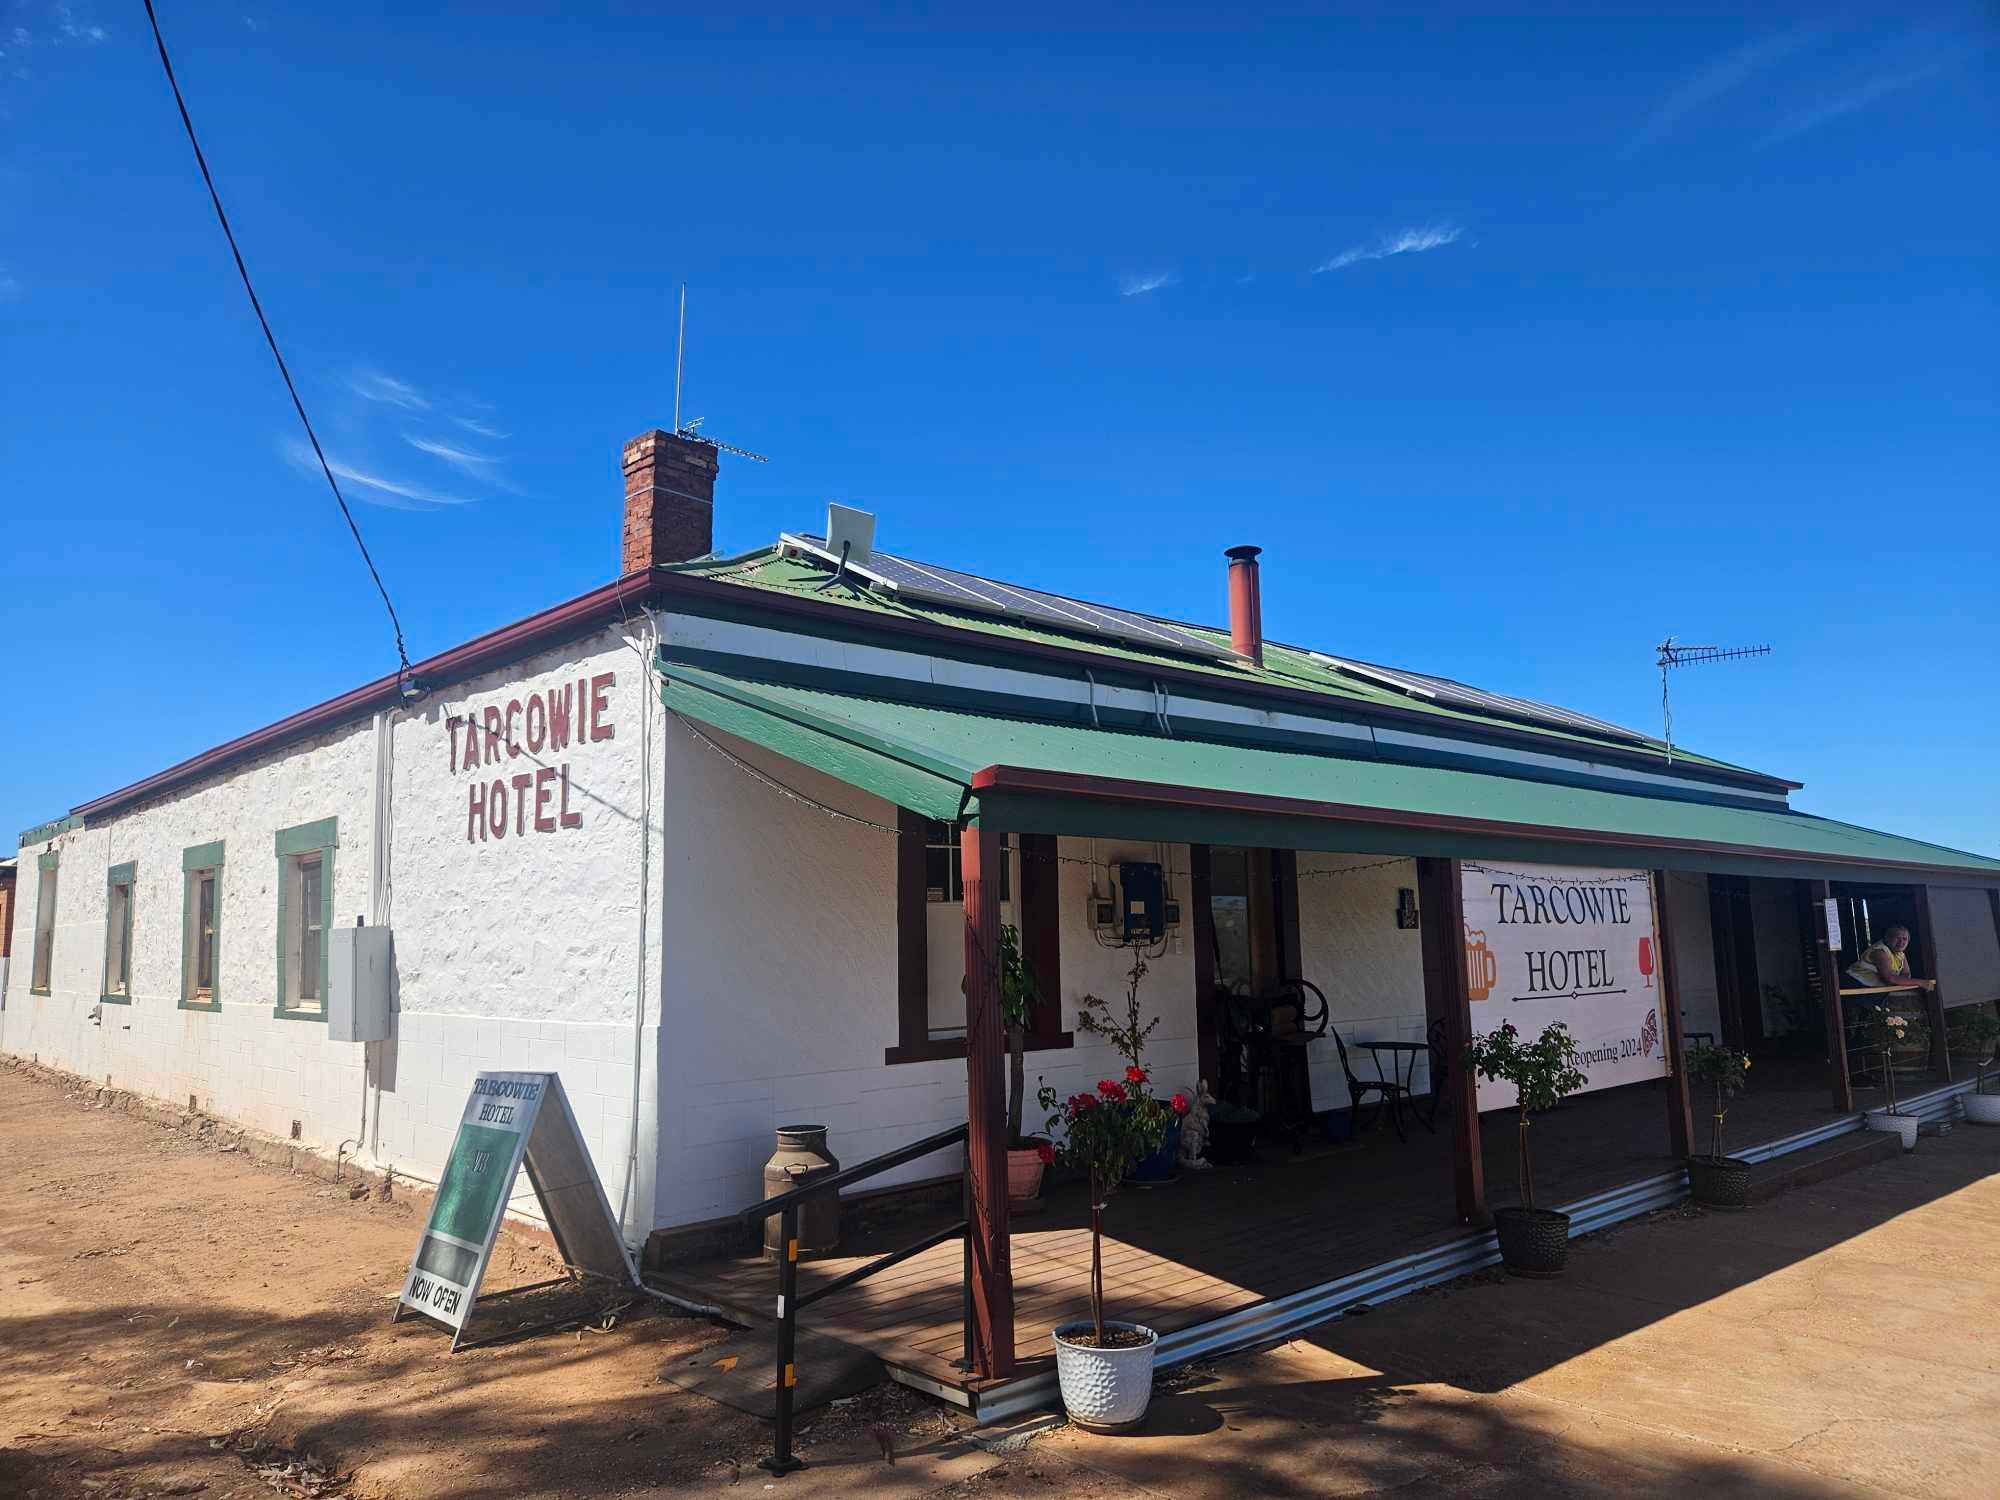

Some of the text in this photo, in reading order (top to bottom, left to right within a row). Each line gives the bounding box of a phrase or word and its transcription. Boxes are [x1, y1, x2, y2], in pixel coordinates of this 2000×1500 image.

[446, 672, 616, 775] TARCOWIE
[467, 763, 583, 844] HOTEL
[1491, 884, 1631, 925] TARCOWIE
[1525, 949, 1614, 991] HOTEL
[1620, 1038, 1642, 1057] 2024
[474, 1078, 540, 1100] TARCOWIE
[479, 1103, 514, 1125] HOTEL
[408, 1275, 462, 1315] NOW OPEN
